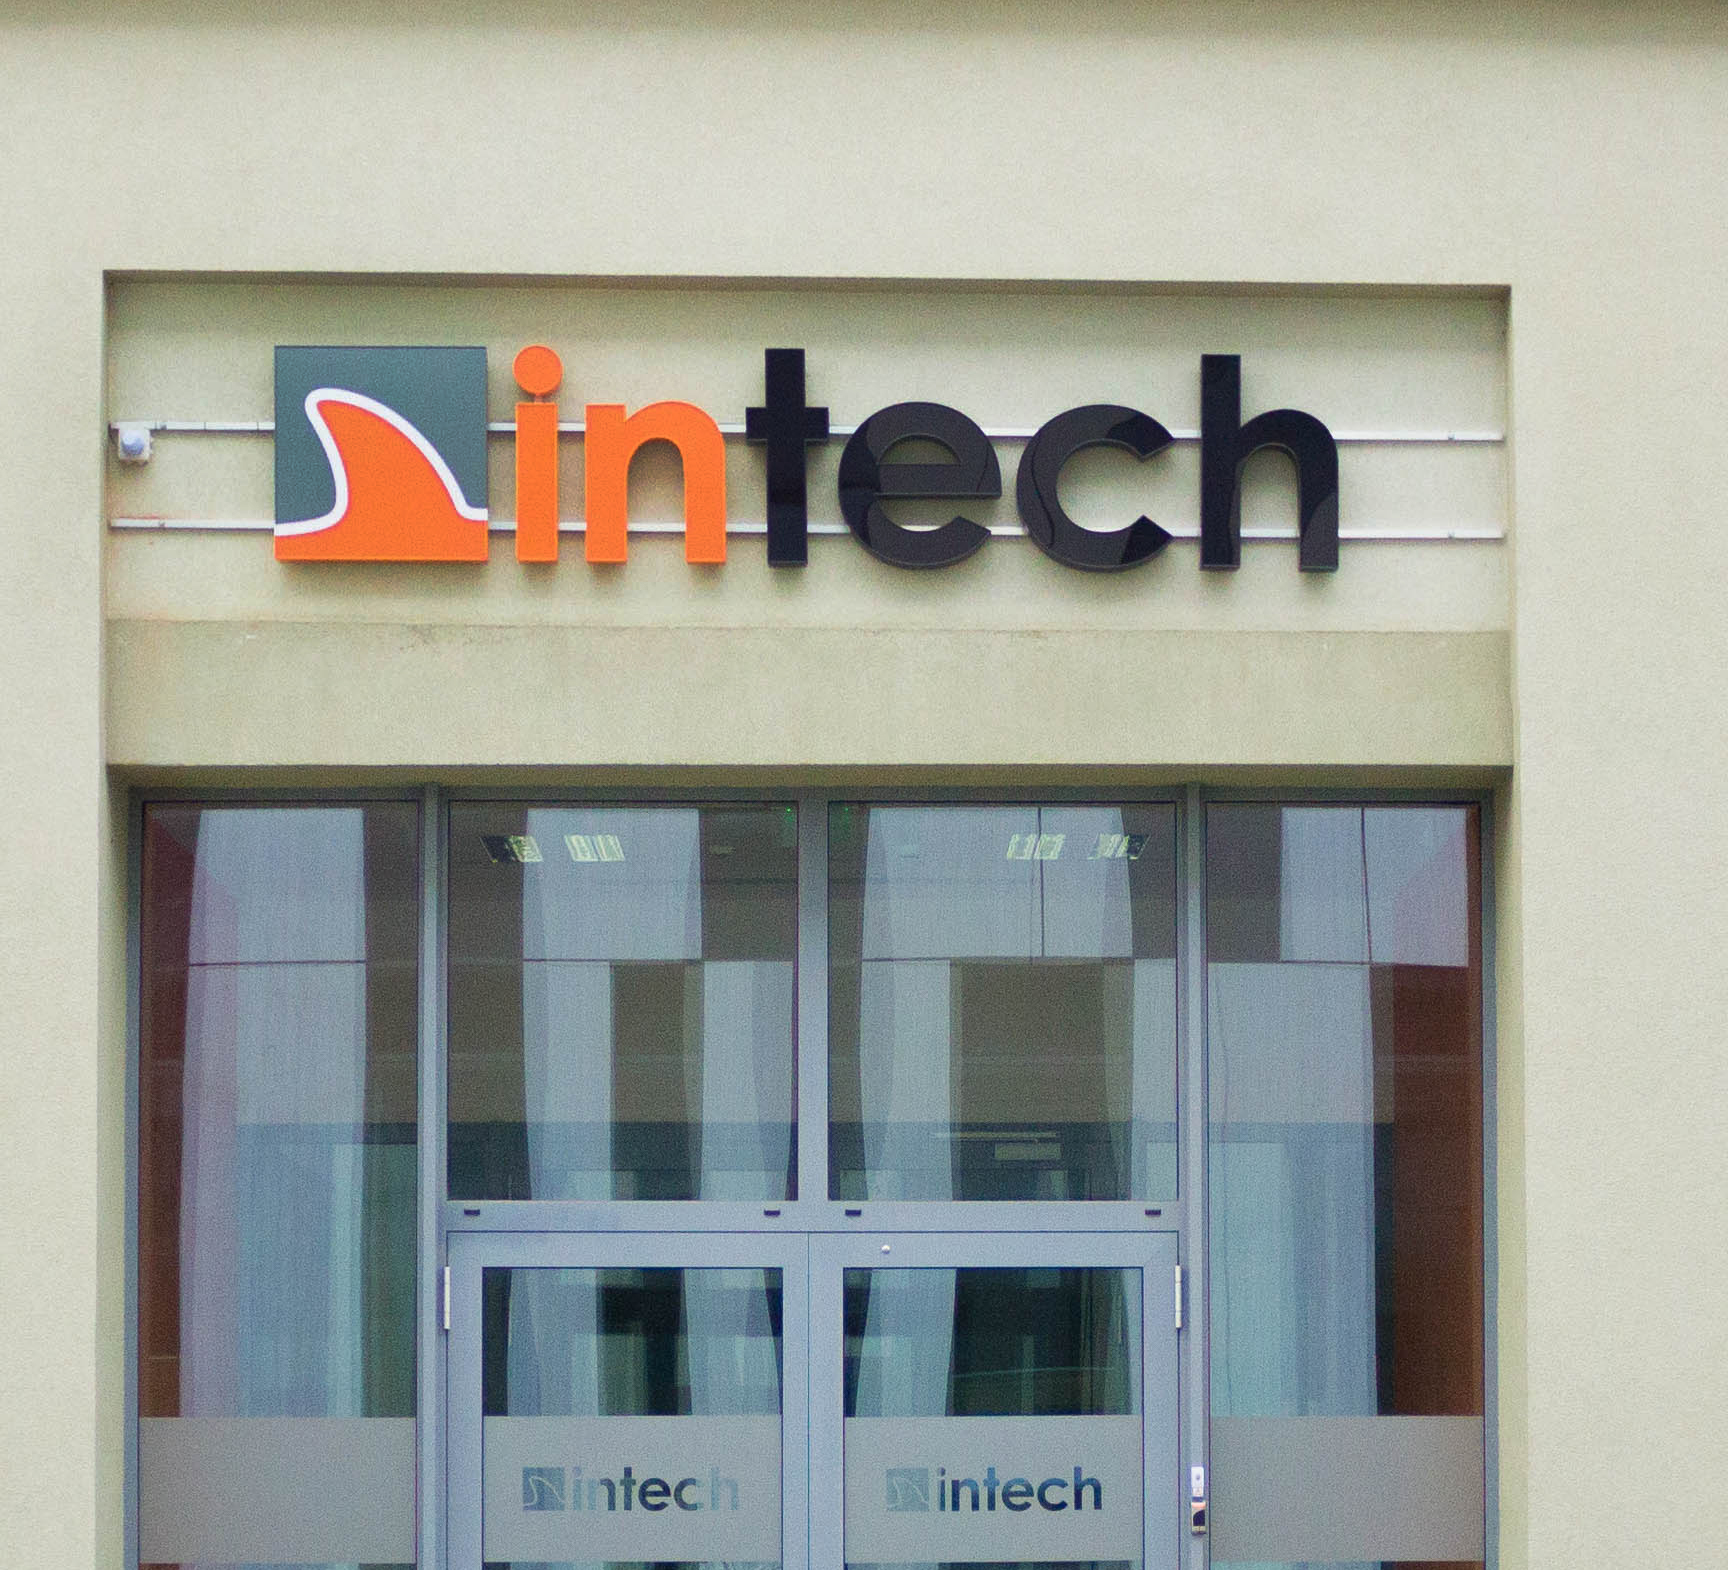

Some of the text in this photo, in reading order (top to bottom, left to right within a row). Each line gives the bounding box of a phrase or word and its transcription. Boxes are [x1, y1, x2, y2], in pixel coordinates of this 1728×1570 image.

[513, 344, 1340, 572] intech
[572, 1466, 739, 1512] intech
[937, 1466, 1103, 1512] intech
